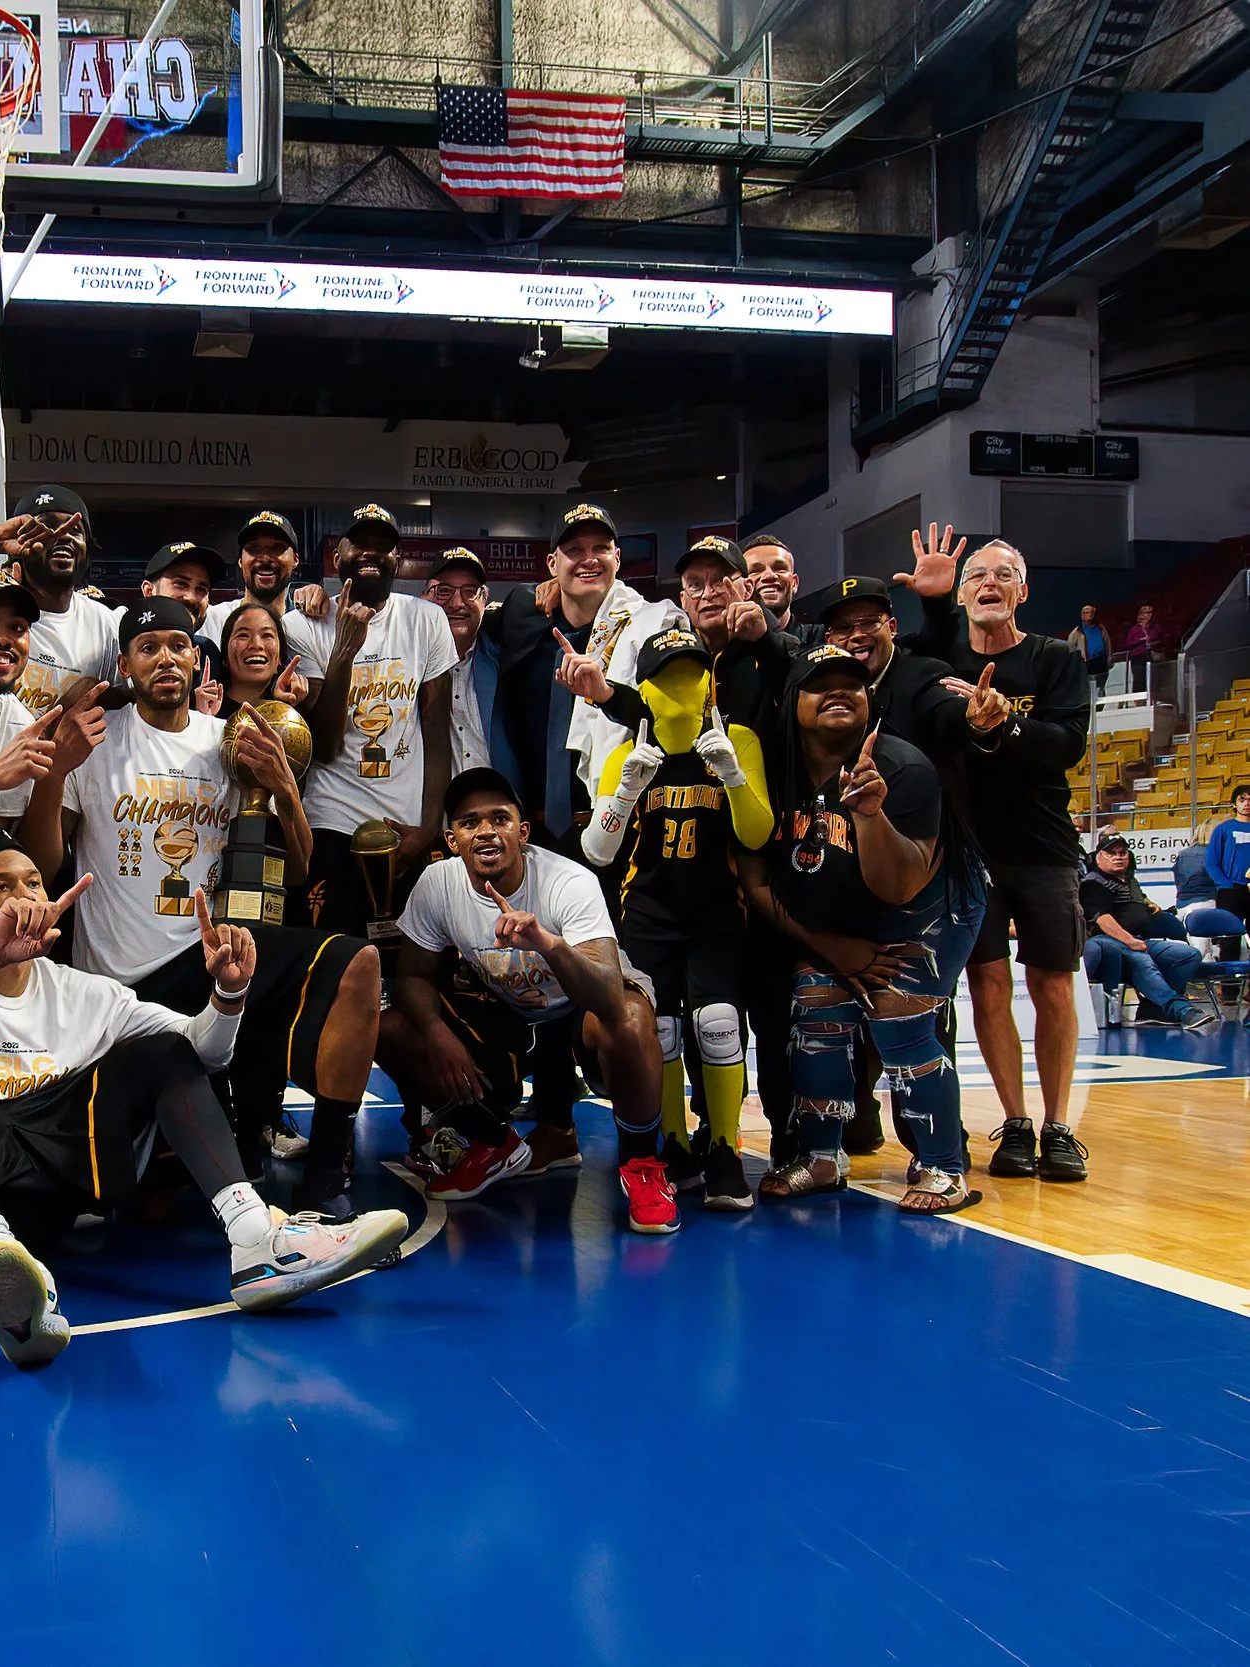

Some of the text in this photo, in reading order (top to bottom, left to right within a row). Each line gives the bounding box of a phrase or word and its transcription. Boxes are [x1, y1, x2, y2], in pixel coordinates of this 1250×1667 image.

[74, 266, 145, 278] FRONTLINE
[196, 270, 267, 282] FRONTLINE
[81, 278, 154, 291] FORWARD
[315, 275, 384, 287] FRONTLINE
[203, 282, 275, 295] FORWARD
[323, 287, 393, 300] FORWARD
[519, 284, 585, 296] FRONTLINE
[633, 289, 697, 301] FRONTLINE
[527, 296, 594, 309] FORWARD
[640, 301, 705, 314] FORWARD
[742, 295, 805, 307] FRONTLINE
[749, 307, 813, 320] FORWARD
[985, 436, 1005, 447] City
[1104, 441, 1123, 452] City
[29, 433, 76, 463] DOM
[84, 434, 182, 465] CARDILLO
[188, 436, 251, 467] ARENA
[413, 446, 559, 471] ERB GOOD
[412, 474, 556, 489] FAMILY FUNERAL HOME
[488, 543, 536, 560] BELL
[841, 578, 858, 597] P
[135, 776, 216, 804] NBLC
[644, 784, 726, 814] IGHTNING
[112, 793, 231, 832] CHAMPIONS
[662, 817, 697, 859] 28
[1150, 836, 1191, 850] Fairw
[1135, 855, 1156, 866] 519
[1, 1041, 20, 1049] 2022
